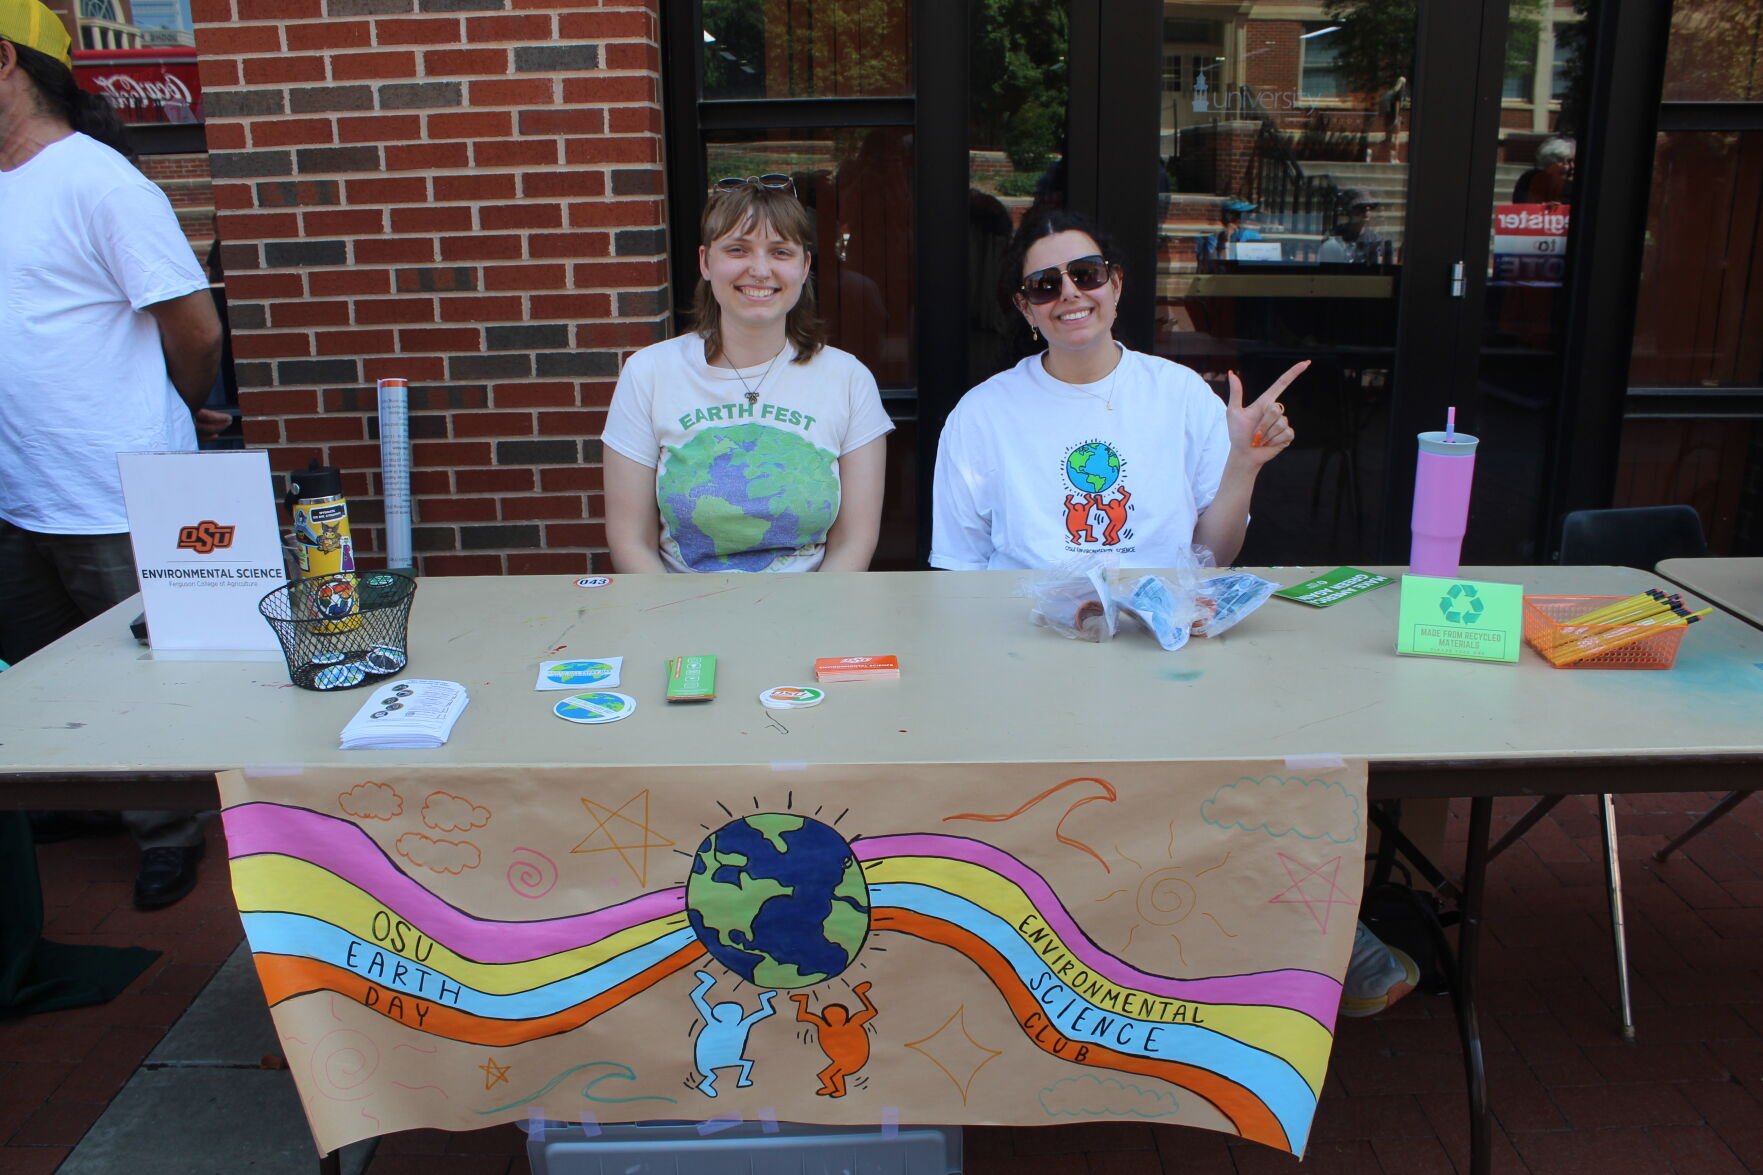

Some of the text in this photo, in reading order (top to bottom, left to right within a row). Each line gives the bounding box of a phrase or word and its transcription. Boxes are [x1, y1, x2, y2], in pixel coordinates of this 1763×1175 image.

[1212, 87, 1322, 115] university
[678, 403, 816, 431] EARTH FEST
[176, 520, 235, 554] OSU
[142, 569, 282, 579] ENVIRONMENTAL SCIENCE
[1331, 574, 1369, 590] GREEN
[1356, 575, 1388, 590] MAKE
[1421, 628, 1502, 642] MADE FROM RECYCLED
[1439, 639, 1480, 649] MATERIALS
[372, 911, 434, 962] OSU
[347, 941, 461, 1004] EARTH
[1018, 914, 1204, 1023] ENVIRONMENTAL
[365, 986, 429, 1026] DAY
[1030, 972, 1165, 1051] SCIENCE
[1024, 1012, 1089, 1062] CLUB
